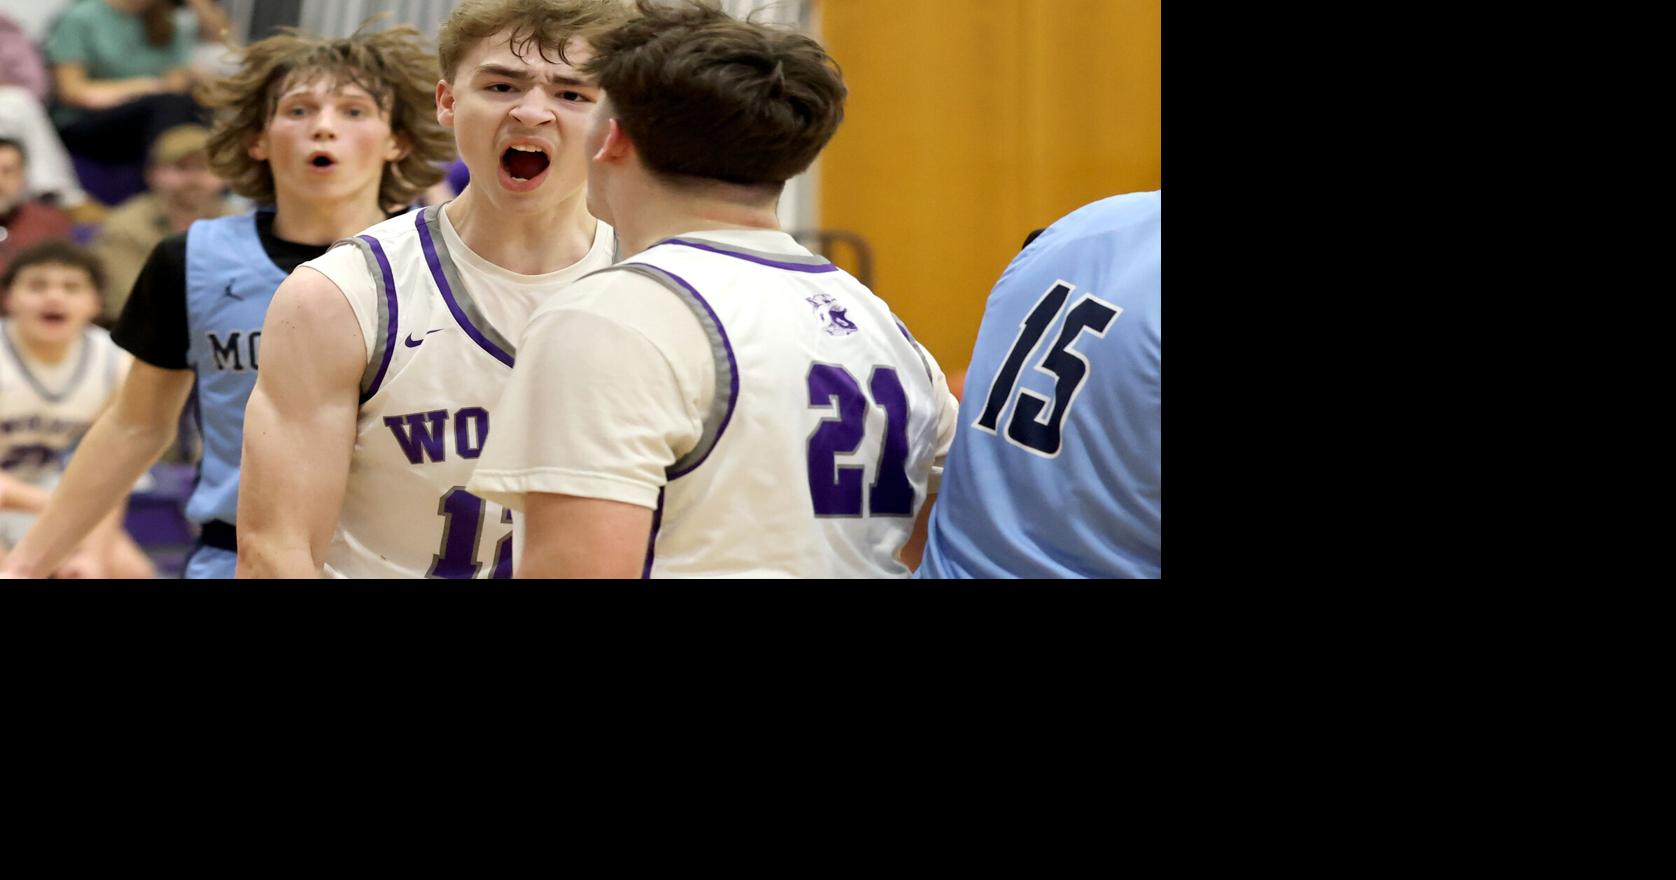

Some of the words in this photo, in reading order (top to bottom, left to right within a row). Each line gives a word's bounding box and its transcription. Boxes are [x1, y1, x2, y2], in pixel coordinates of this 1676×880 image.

[383, 406, 490, 465] WO
[806, 360, 916, 518] 21
[971, 278, 1124, 459] 15
